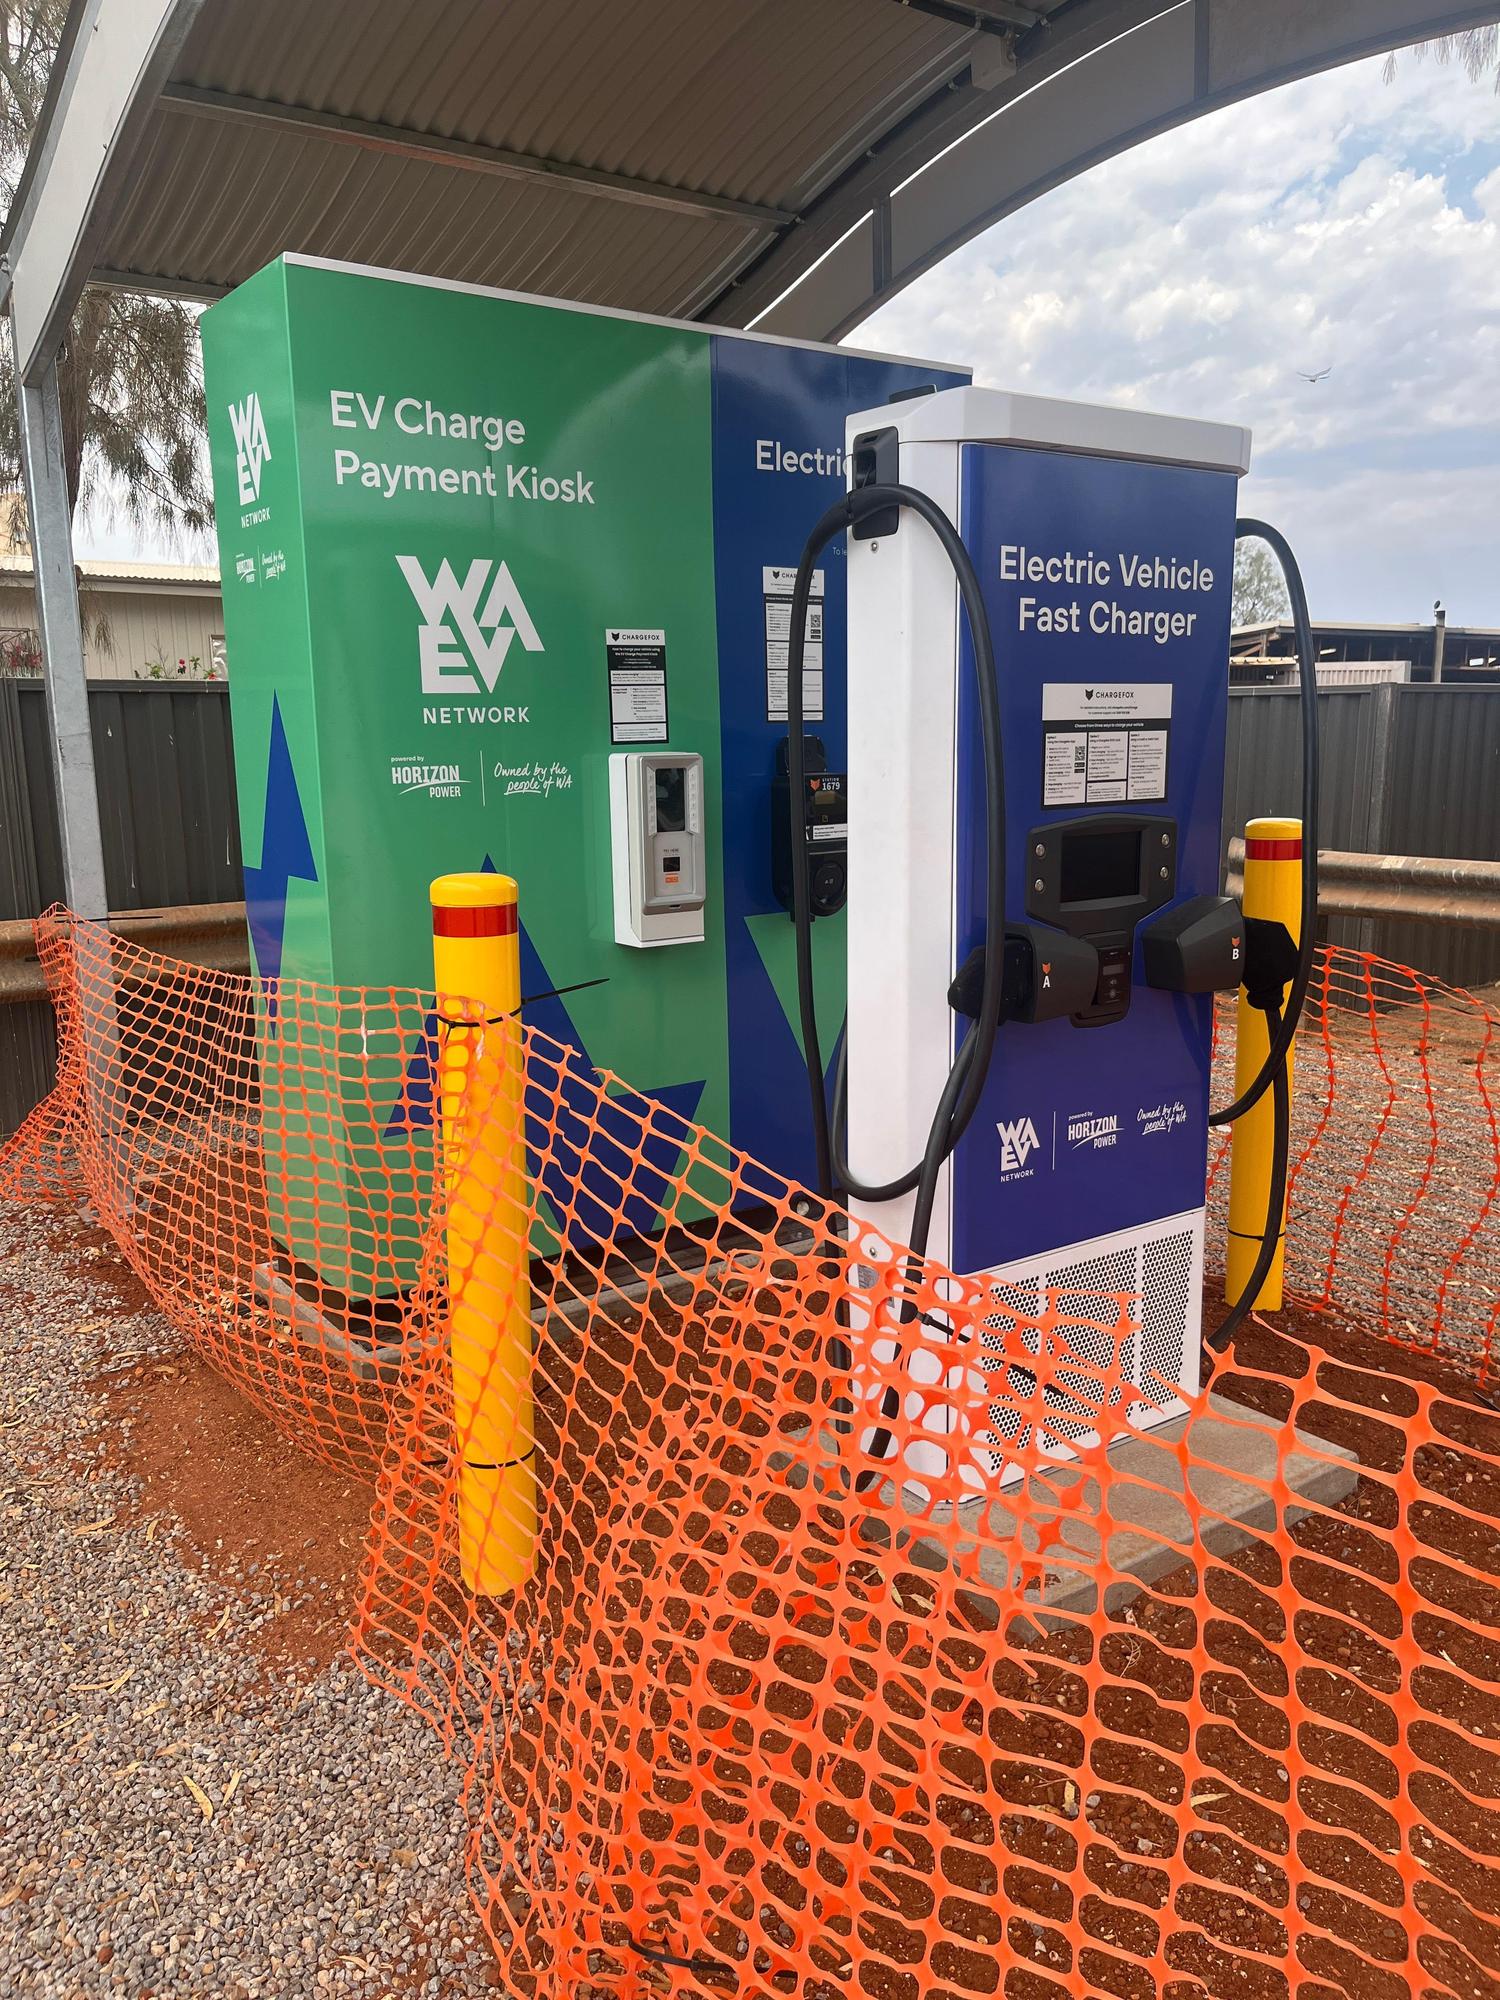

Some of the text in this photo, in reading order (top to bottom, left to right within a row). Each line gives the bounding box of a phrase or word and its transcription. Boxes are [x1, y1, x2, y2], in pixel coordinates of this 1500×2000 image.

[329, 389, 526, 451] EV Charge
[334, 449, 595, 505] Payment Kiosk
[240, 507, 271, 529] NETWORK
[1000, 545, 1214, 592] Electric Vehicle
[1018, 597, 1197, 645] Fast Charger
[1095, 691, 1134, 699] CHARGEFOX
[423, 705, 530, 725] NETWORK
[416, 755, 425, 763] by
[391, 764, 460, 784] HORIZON
[493, 761, 568, 782] Owned by the
[429, 785, 462, 798] POWER
[507, 774, 573, 798] people of WA
[821, 781, 841, 791] 1679
[1232, 948, 1239, 960] B
[1042, 975, 1051, 988] A
[1068, 1110, 1094, 1121] powered by
[1136, 1100, 1184, 1122] Owned by the
[1068, 1114, 1118, 1141] HORIZON
[1093, 1134, 1117, 1149] POWER
[1000, 1168, 1034, 1183] NETWORK
